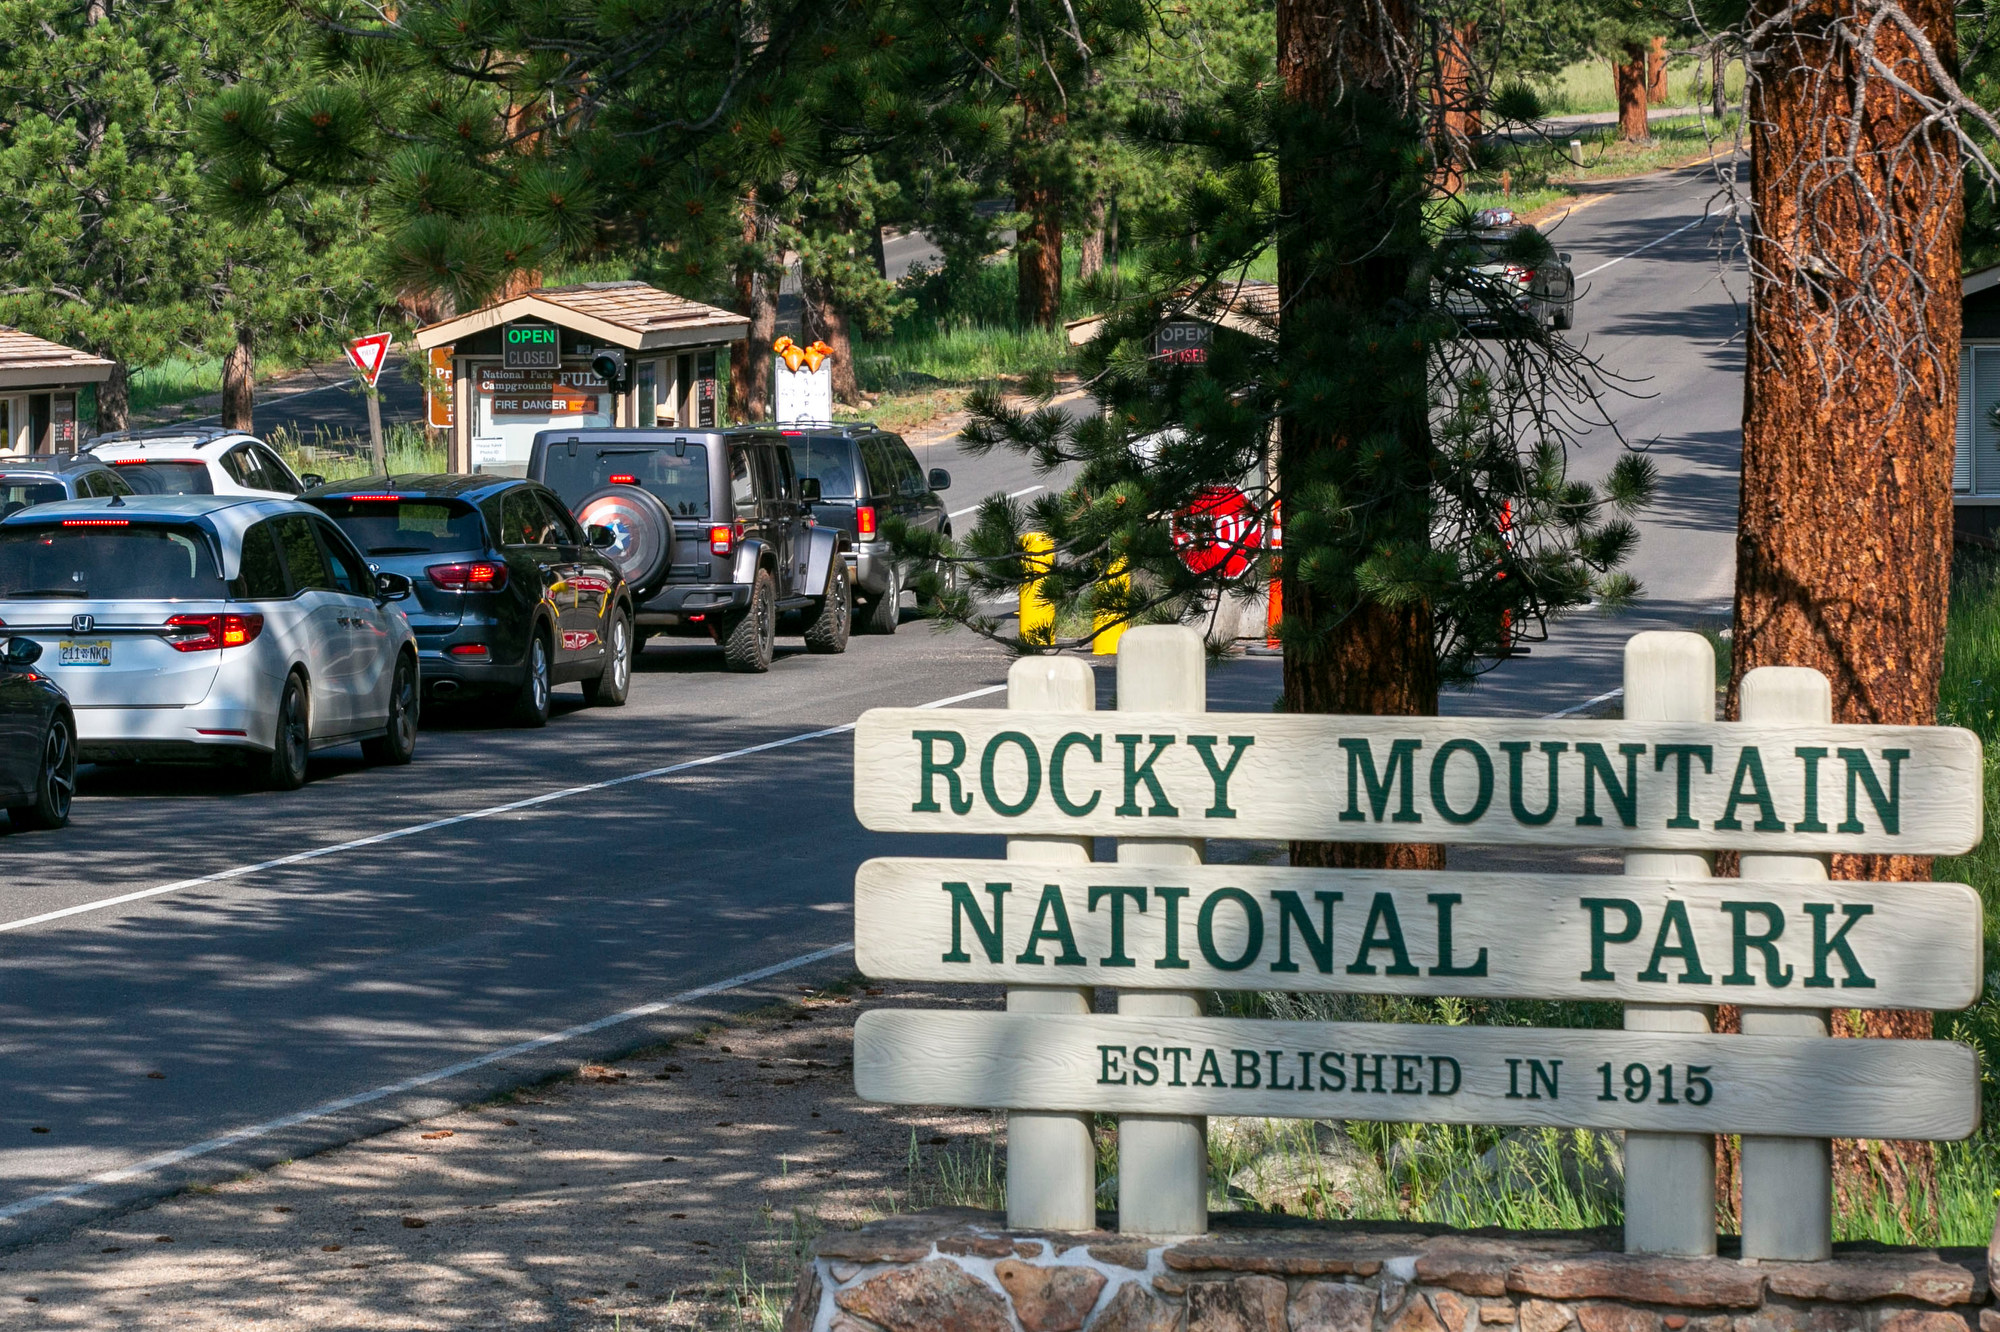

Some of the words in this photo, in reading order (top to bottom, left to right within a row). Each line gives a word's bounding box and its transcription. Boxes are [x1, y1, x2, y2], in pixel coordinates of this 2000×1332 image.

[508, 329, 555, 344] OPEN
[1161, 326, 1208, 342] OPEN
[509, 351, 554, 364] CLOSED
[482, 370, 525, 379] National
[530, 370, 554, 379] Park
[482, 381, 553, 392] Campgrounds
[495, 400, 518, 409] FIRE
[522, 400, 567, 410] DANGER
[912, 730, 1255, 818] ROCKY
[1338, 738, 1910, 835] MOUNTAIN
[941, 882, 1488, 978] NATIONAL
[1580, 897, 1876, 988] PARK
[1097, 1045, 1462, 1096] ESTABLISHED
[1504, 1058, 1563, 1101] IN
[1596, 1061, 1714, 1107] 1915
